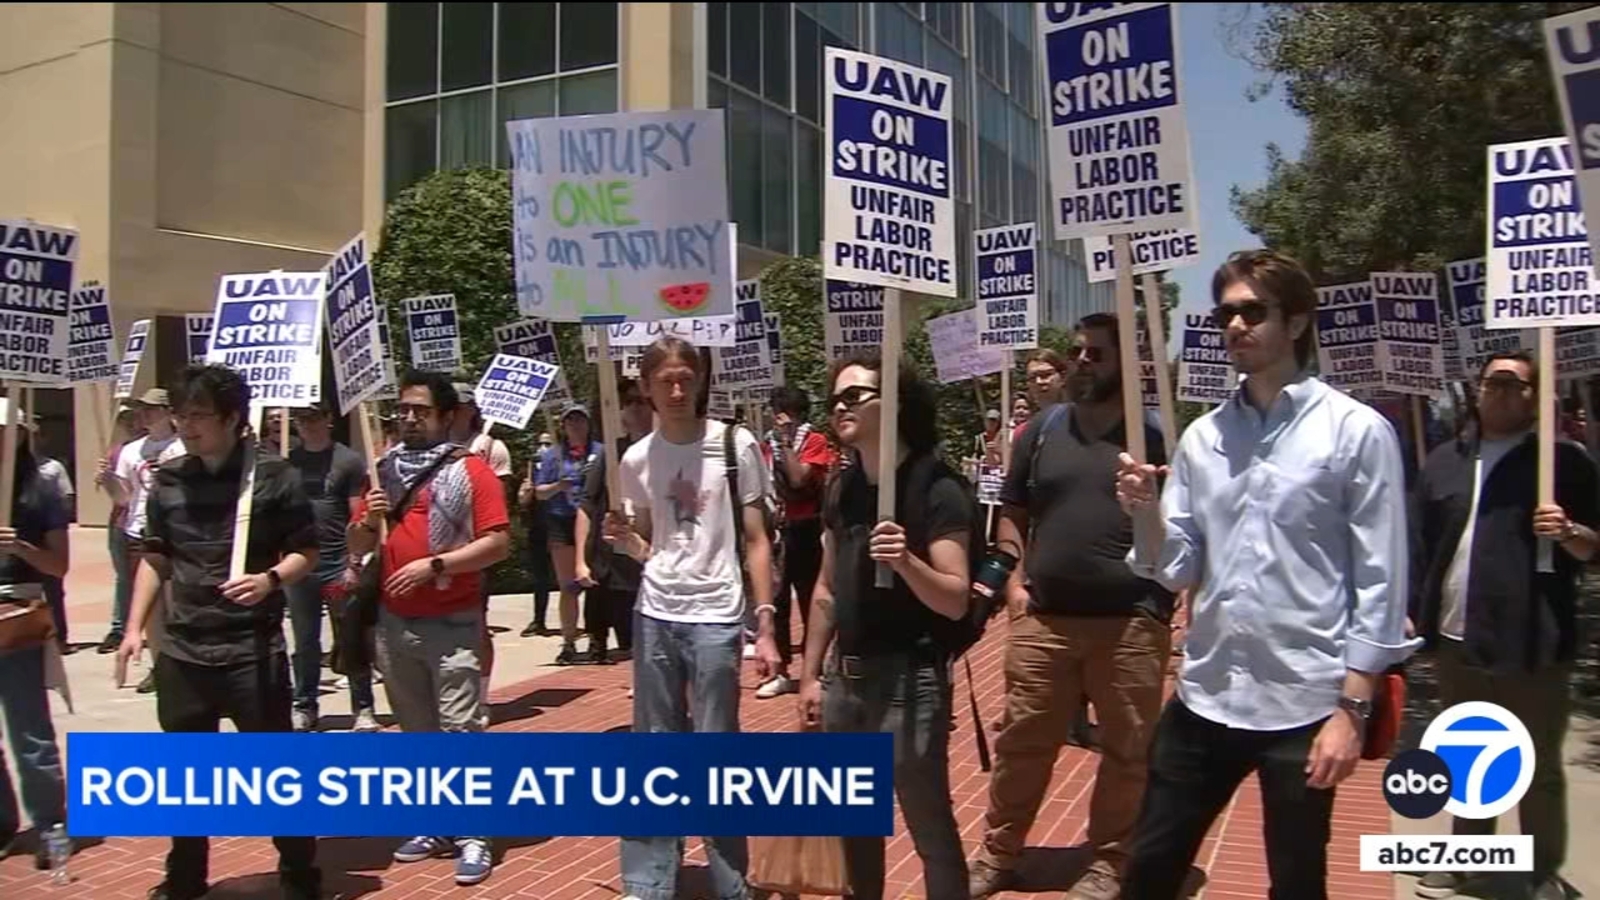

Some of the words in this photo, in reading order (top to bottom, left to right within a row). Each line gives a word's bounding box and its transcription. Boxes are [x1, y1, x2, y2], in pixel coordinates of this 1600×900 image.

[1082, 22, 1130, 67] ON
[834, 57, 947, 111] UAW
[1054, 61, 1172, 117] STRIKE
[871, 109, 915, 147] ON
[1068, 116, 1162, 158] UNFAIR
[560, 122, 697, 178] INJURY
[836, 139, 946, 190] STRIKE
[1075, 152, 1159, 190] LABOR
[1496, 146, 1574, 177] UA
[518, 189, 539, 219] to
[552, 181, 641, 228] ONE
[850, 185, 935, 224] UNFAIR
[1060, 184, 1184, 225] PRACTICE
[1528, 181, 1573, 210] ON
[855, 215, 932, 253] LABOR
[1497, 211, 1587, 241] STRIK
[0, 225, 76, 256] AW
[518, 229, 537, 263] is
[546, 238, 584, 267] an
[592, 221, 721, 275] INJURY
[978, 228, 1032, 252] UAW
[5, 259, 43, 282] ON
[835, 242, 951, 284] PRACTICE
[994, 254, 1016, 273] ON
[1452, 262, 1486, 283] UA
[226, 278, 321, 298] UAW
[519, 271, 543, 309] to
[980, 273, 1034, 296] STRIKE
[1375, 277, 1434, 295] UAW
[1513, 270, 1588, 294] LABOR
[0, 283, 69, 310] TRIKE
[72, 288, 104, 305] AW
[338, 280, 356, 311] ON
[409, 297, 454, 312] UAW
[830, 291, 884, 311] STRIK
[249, 303, 287, 322] ON
[986, 299, 1027, 315] UNFAIR
[1334, 309, 1358, 326] ON
[1394, 302, 1417, 319] ON
[0, 313, 54, 335] NFAIR
[333, 296, 373, 345] STRIKE
[424, 314, 442, 326] ON
[989, 314, 1026, 329] LABOR
[1380, 321, 1439, 340] STRIKE
[218, 324, 315, 346] STRIKE
[413, 325, 457, 340] STRIKE
[500, 321, 548, 343] UAW
[981, 329, 1035, 346] PRACTICE
[1200, 335, 1222, 348] ON
[1320, 325, 1379, 345] STRIKE
[0, 334, 49, 355] ABOR
[520, 340, 538, 354] ON
[1185, 348, 1230, 362] STRIK
[225, 350, 297, 367] UNFAIR
[498, 358, 555, 376] UAW
[723, 356, 760, 370] LABOR
[1333, 359, 1374, 371] LABOR
[1393, 358, 1432, 371] LABOR
[507, 371, 530, 384] ON
[250, 384, 306, 400] CTICE
[482, 380, 541, 400] STRIKE
[484, 391, 528, 407] UNFAIR
[480, 399, 521, 414] LABOR
